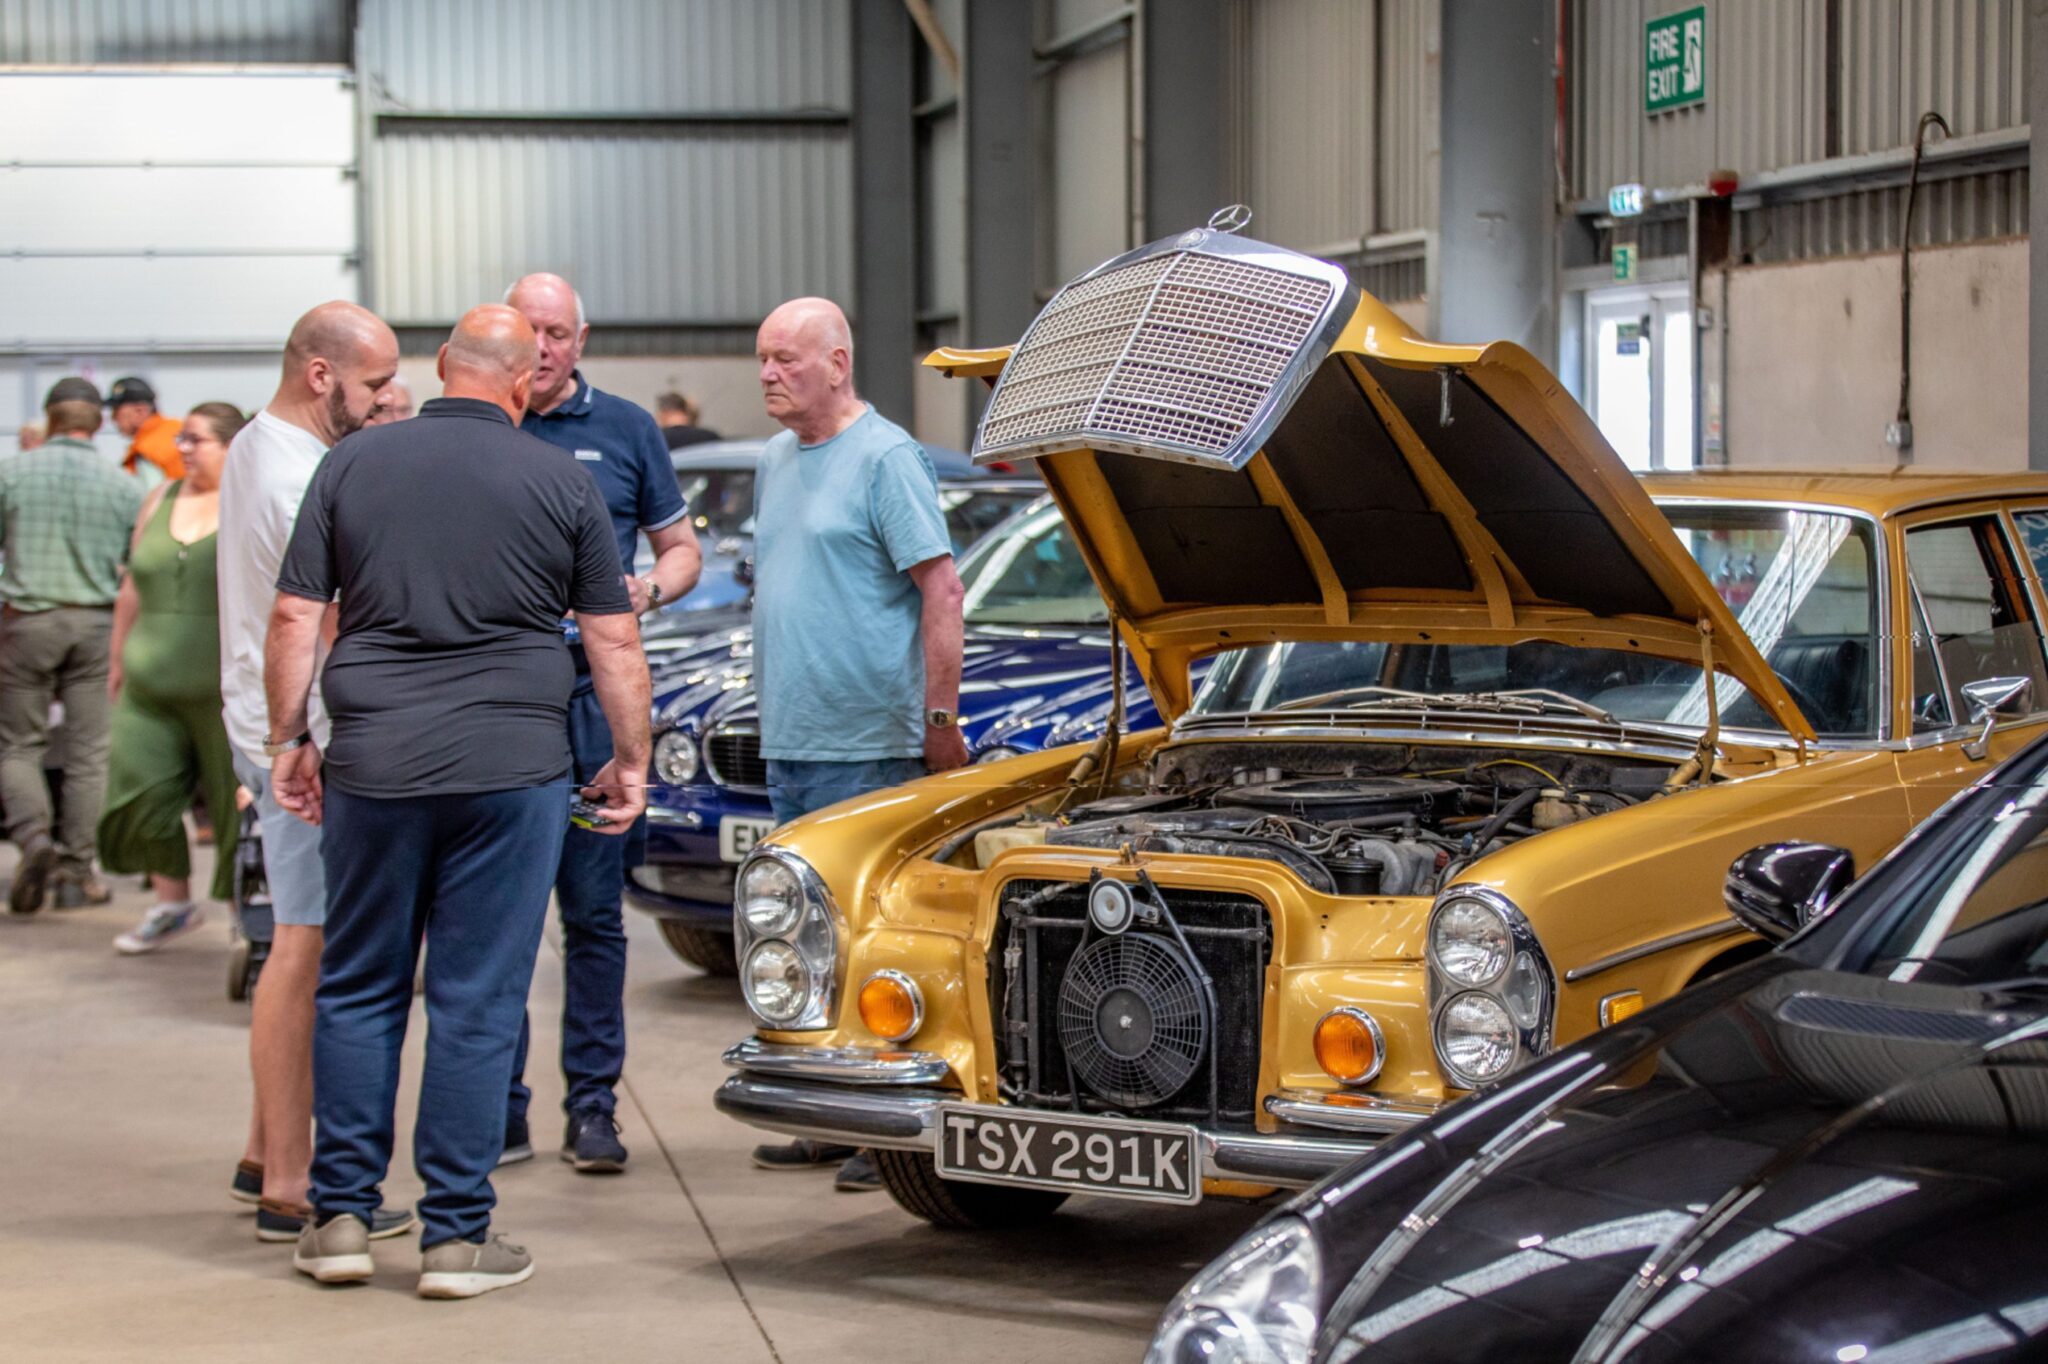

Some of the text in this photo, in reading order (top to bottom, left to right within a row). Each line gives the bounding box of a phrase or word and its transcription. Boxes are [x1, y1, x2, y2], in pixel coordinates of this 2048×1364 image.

[1649, 25, 1679, 63] FIRE
[1648, 64, 1679, 102] EXIT
[946, 1116, 1186, 1190] TSX 291K
